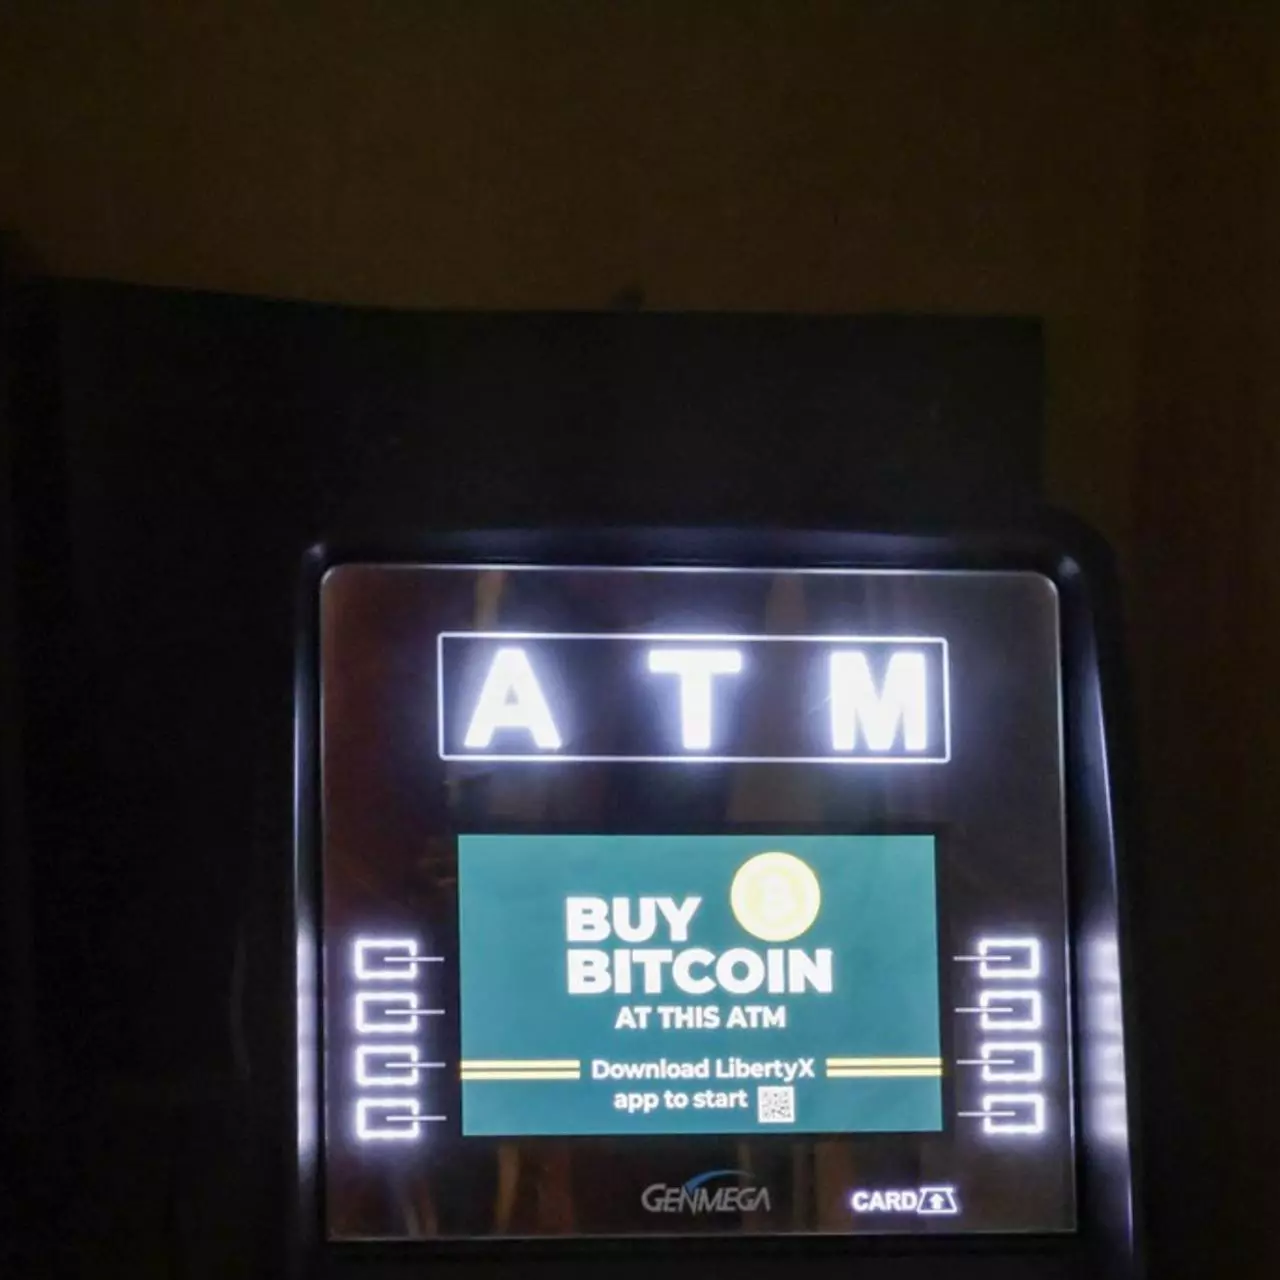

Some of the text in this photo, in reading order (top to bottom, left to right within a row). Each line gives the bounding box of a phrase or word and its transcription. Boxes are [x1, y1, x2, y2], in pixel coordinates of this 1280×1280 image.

[463, 647, 926, 750] ATM
[565, 896, 703, 943] BUY
[567, 947, 833, 995] BITCOIN
[614, 1006, 787, 1029] AT THIS ATM
[591, 1057, 815, 1082] Download LibertyX
[613, 1089, 748, 1113] app to start
[641, 1183, 772, 1216] GENMEGA
[851, 1191, 918, 1212] CARD
